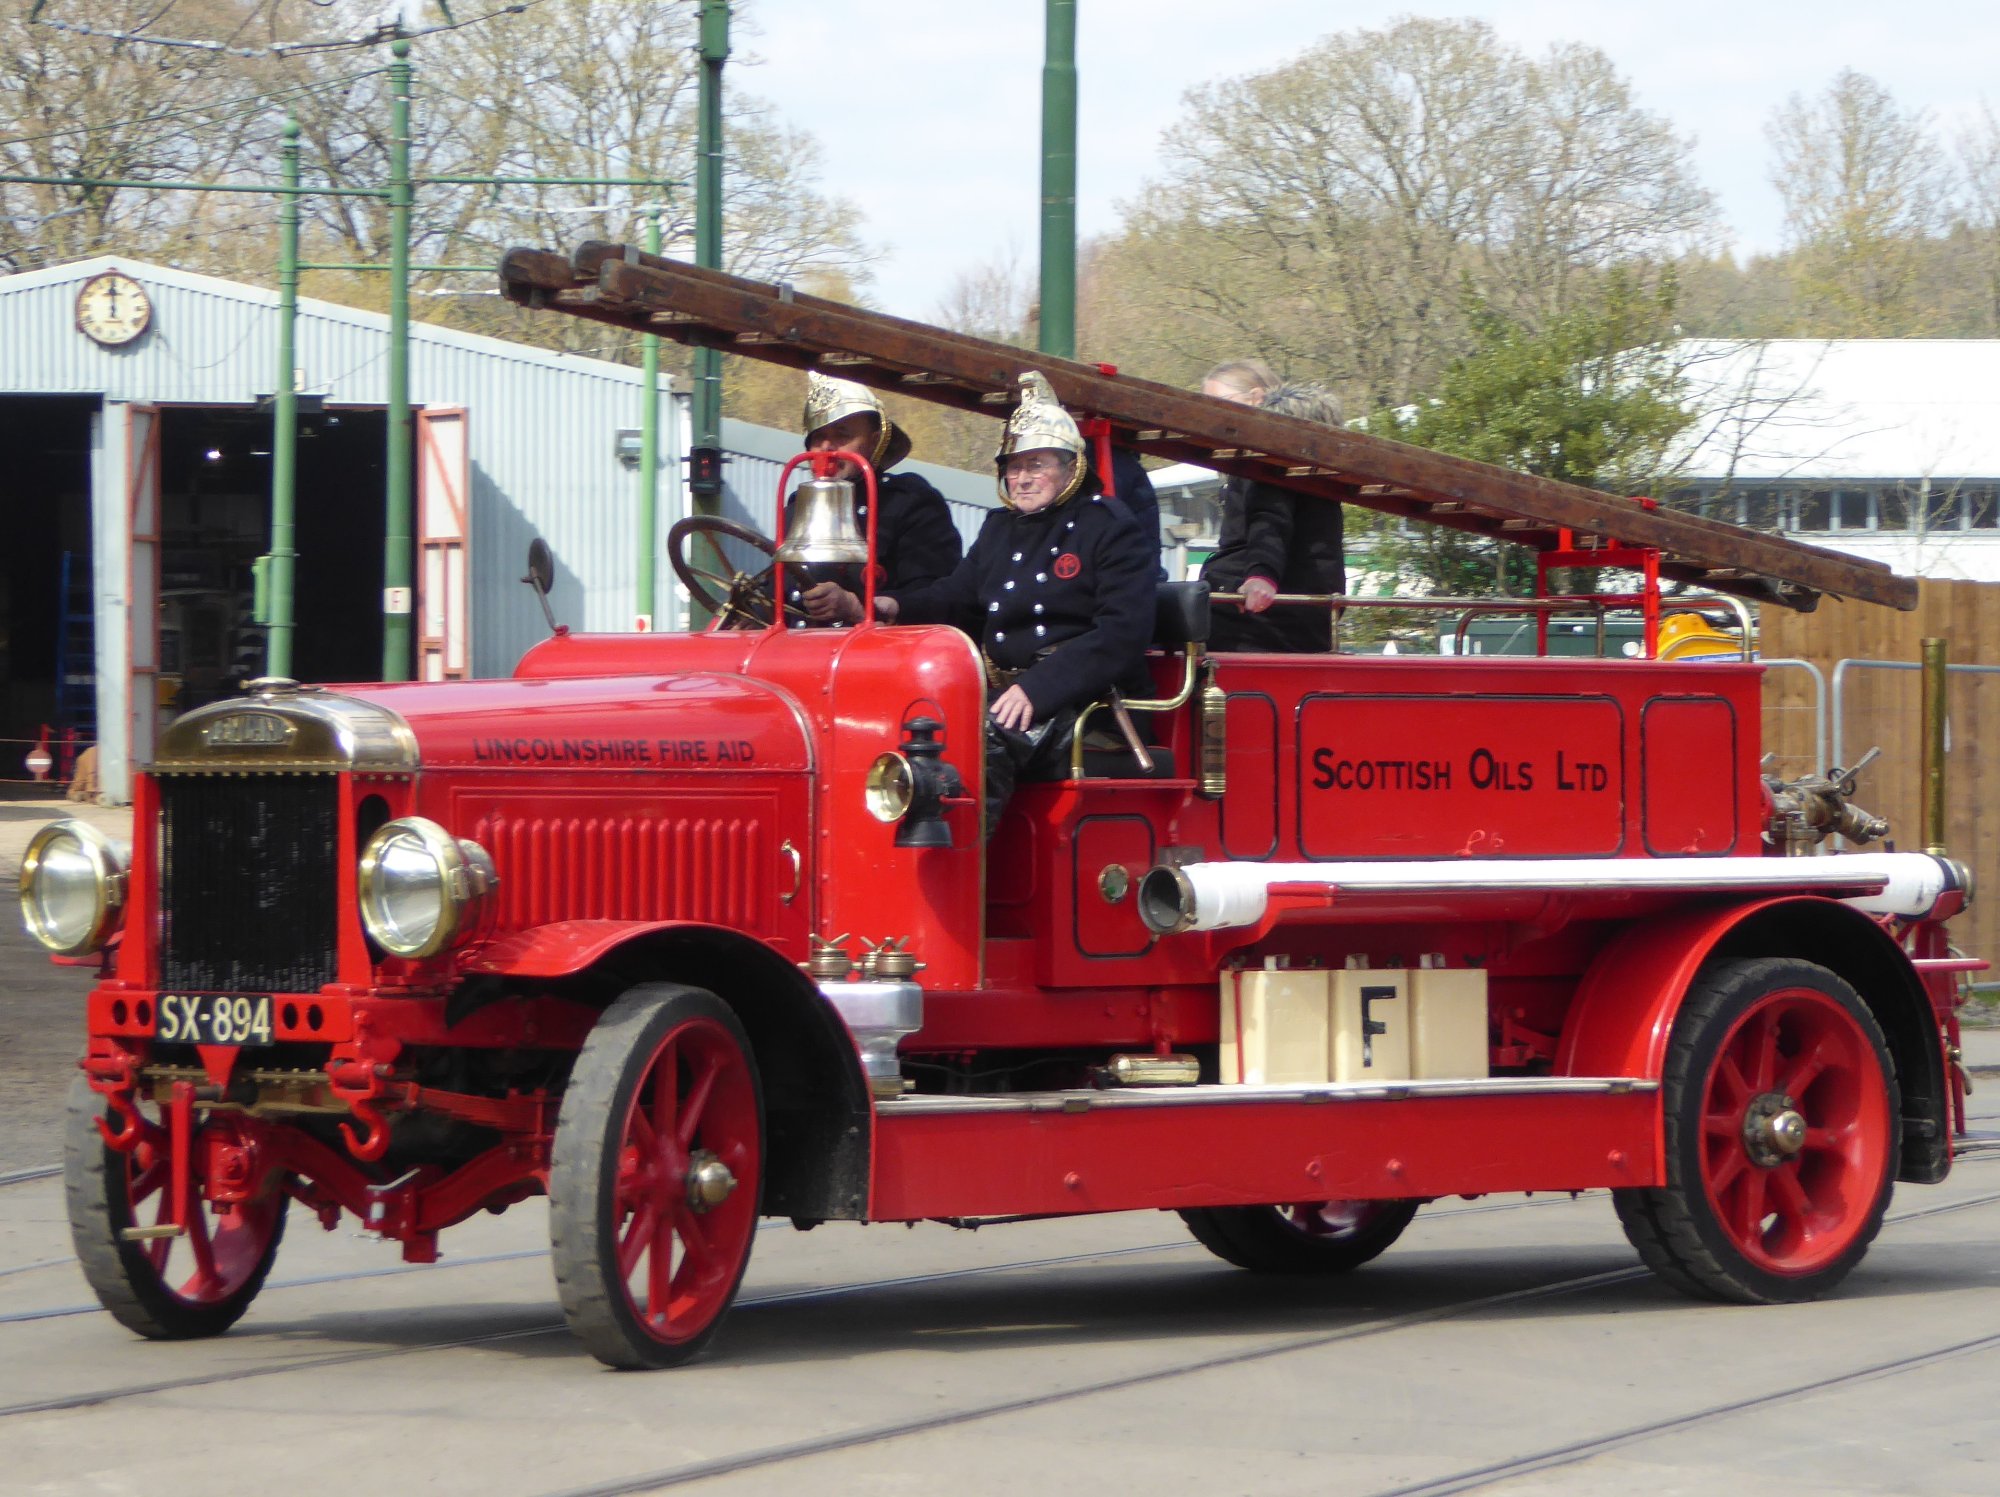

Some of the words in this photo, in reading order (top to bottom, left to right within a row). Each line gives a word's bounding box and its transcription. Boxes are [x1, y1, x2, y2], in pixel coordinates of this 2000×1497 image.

[474, 739, 650, 761] LINCOLNSHIRE
[658, 740, 709, 761] FIRE
[716, 741, 755, 762] AID
[1312, 748, 1451, 789] SCOTTISH
[1469, 748, 1533, 790] OILS
[160, 995, 270, 1042] SX-894
[1360, 986, 1396, 1067] F
